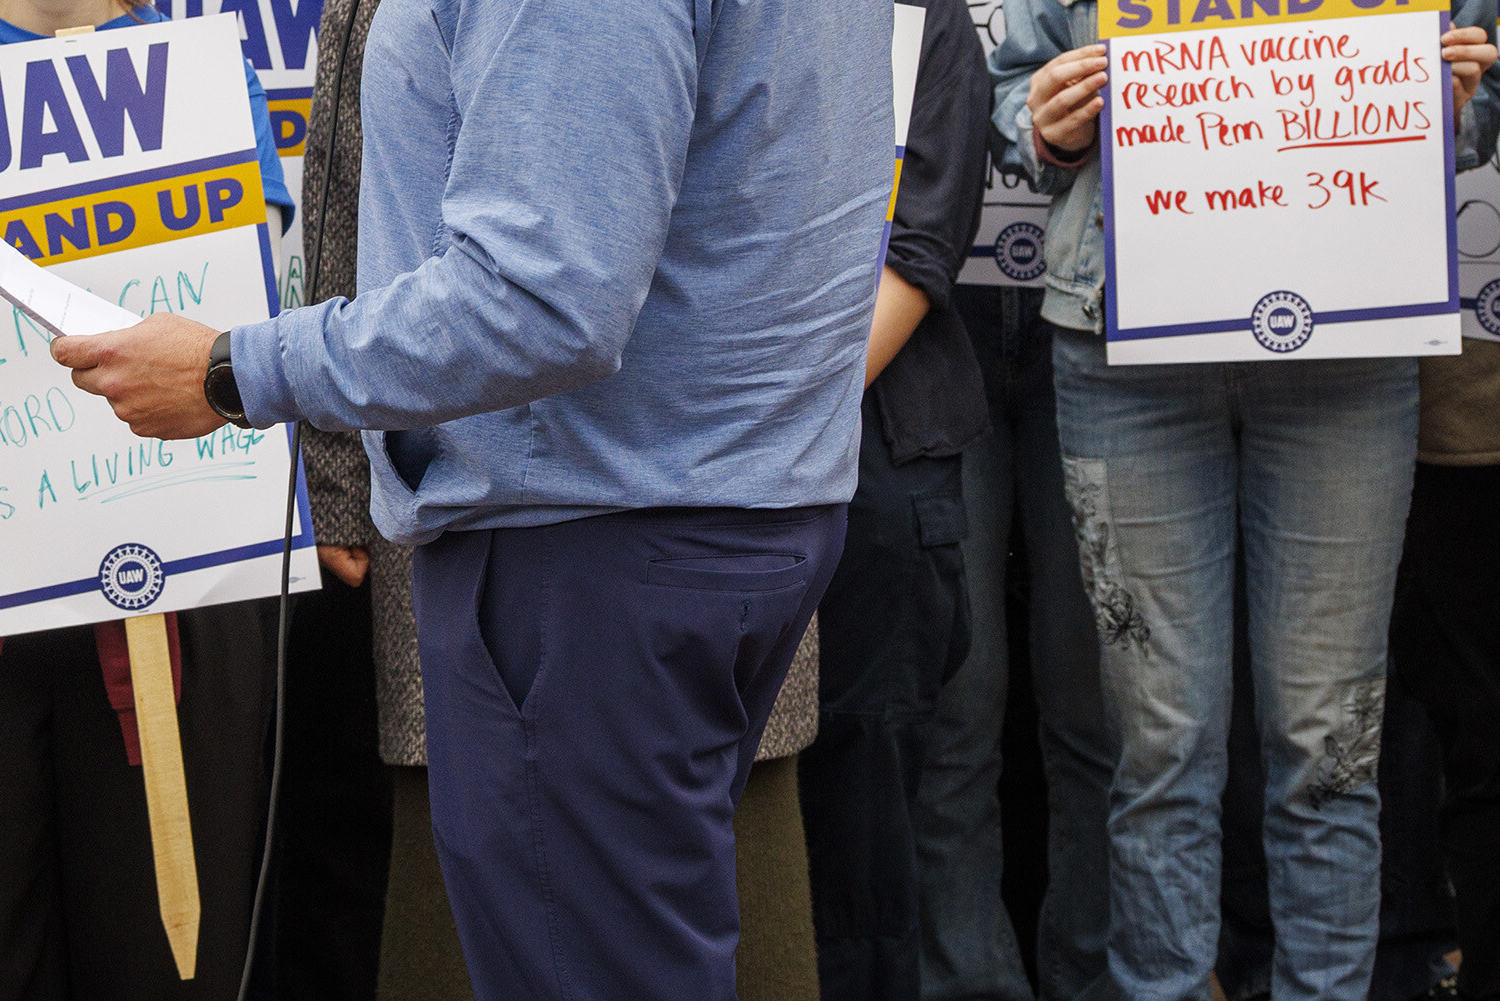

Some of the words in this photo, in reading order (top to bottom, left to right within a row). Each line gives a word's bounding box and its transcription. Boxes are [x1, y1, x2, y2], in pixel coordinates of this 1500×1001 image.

[1121, 36, 1230, 75] mRNA
[1240, 30, 1360, 67] vaccine
[1121, 74, 1255, 110] research
[1270, 70, 1315, 107] by
[1334, 47, 1430, 103] grads
[1116, 115, 1191, 147] made
[1275, 100, 1431, 142] BILLIONS
[156, 178, 244, 231] UP
[1146, 189, 1194, 216] we
[1205, 180, 1288, 212] make
[1268, 315, 1293, 330] UAW
[38, 469, 56, 508] A
[71, 437, 174, 493] LIVING
[118, 570, 144, 585] UAW
